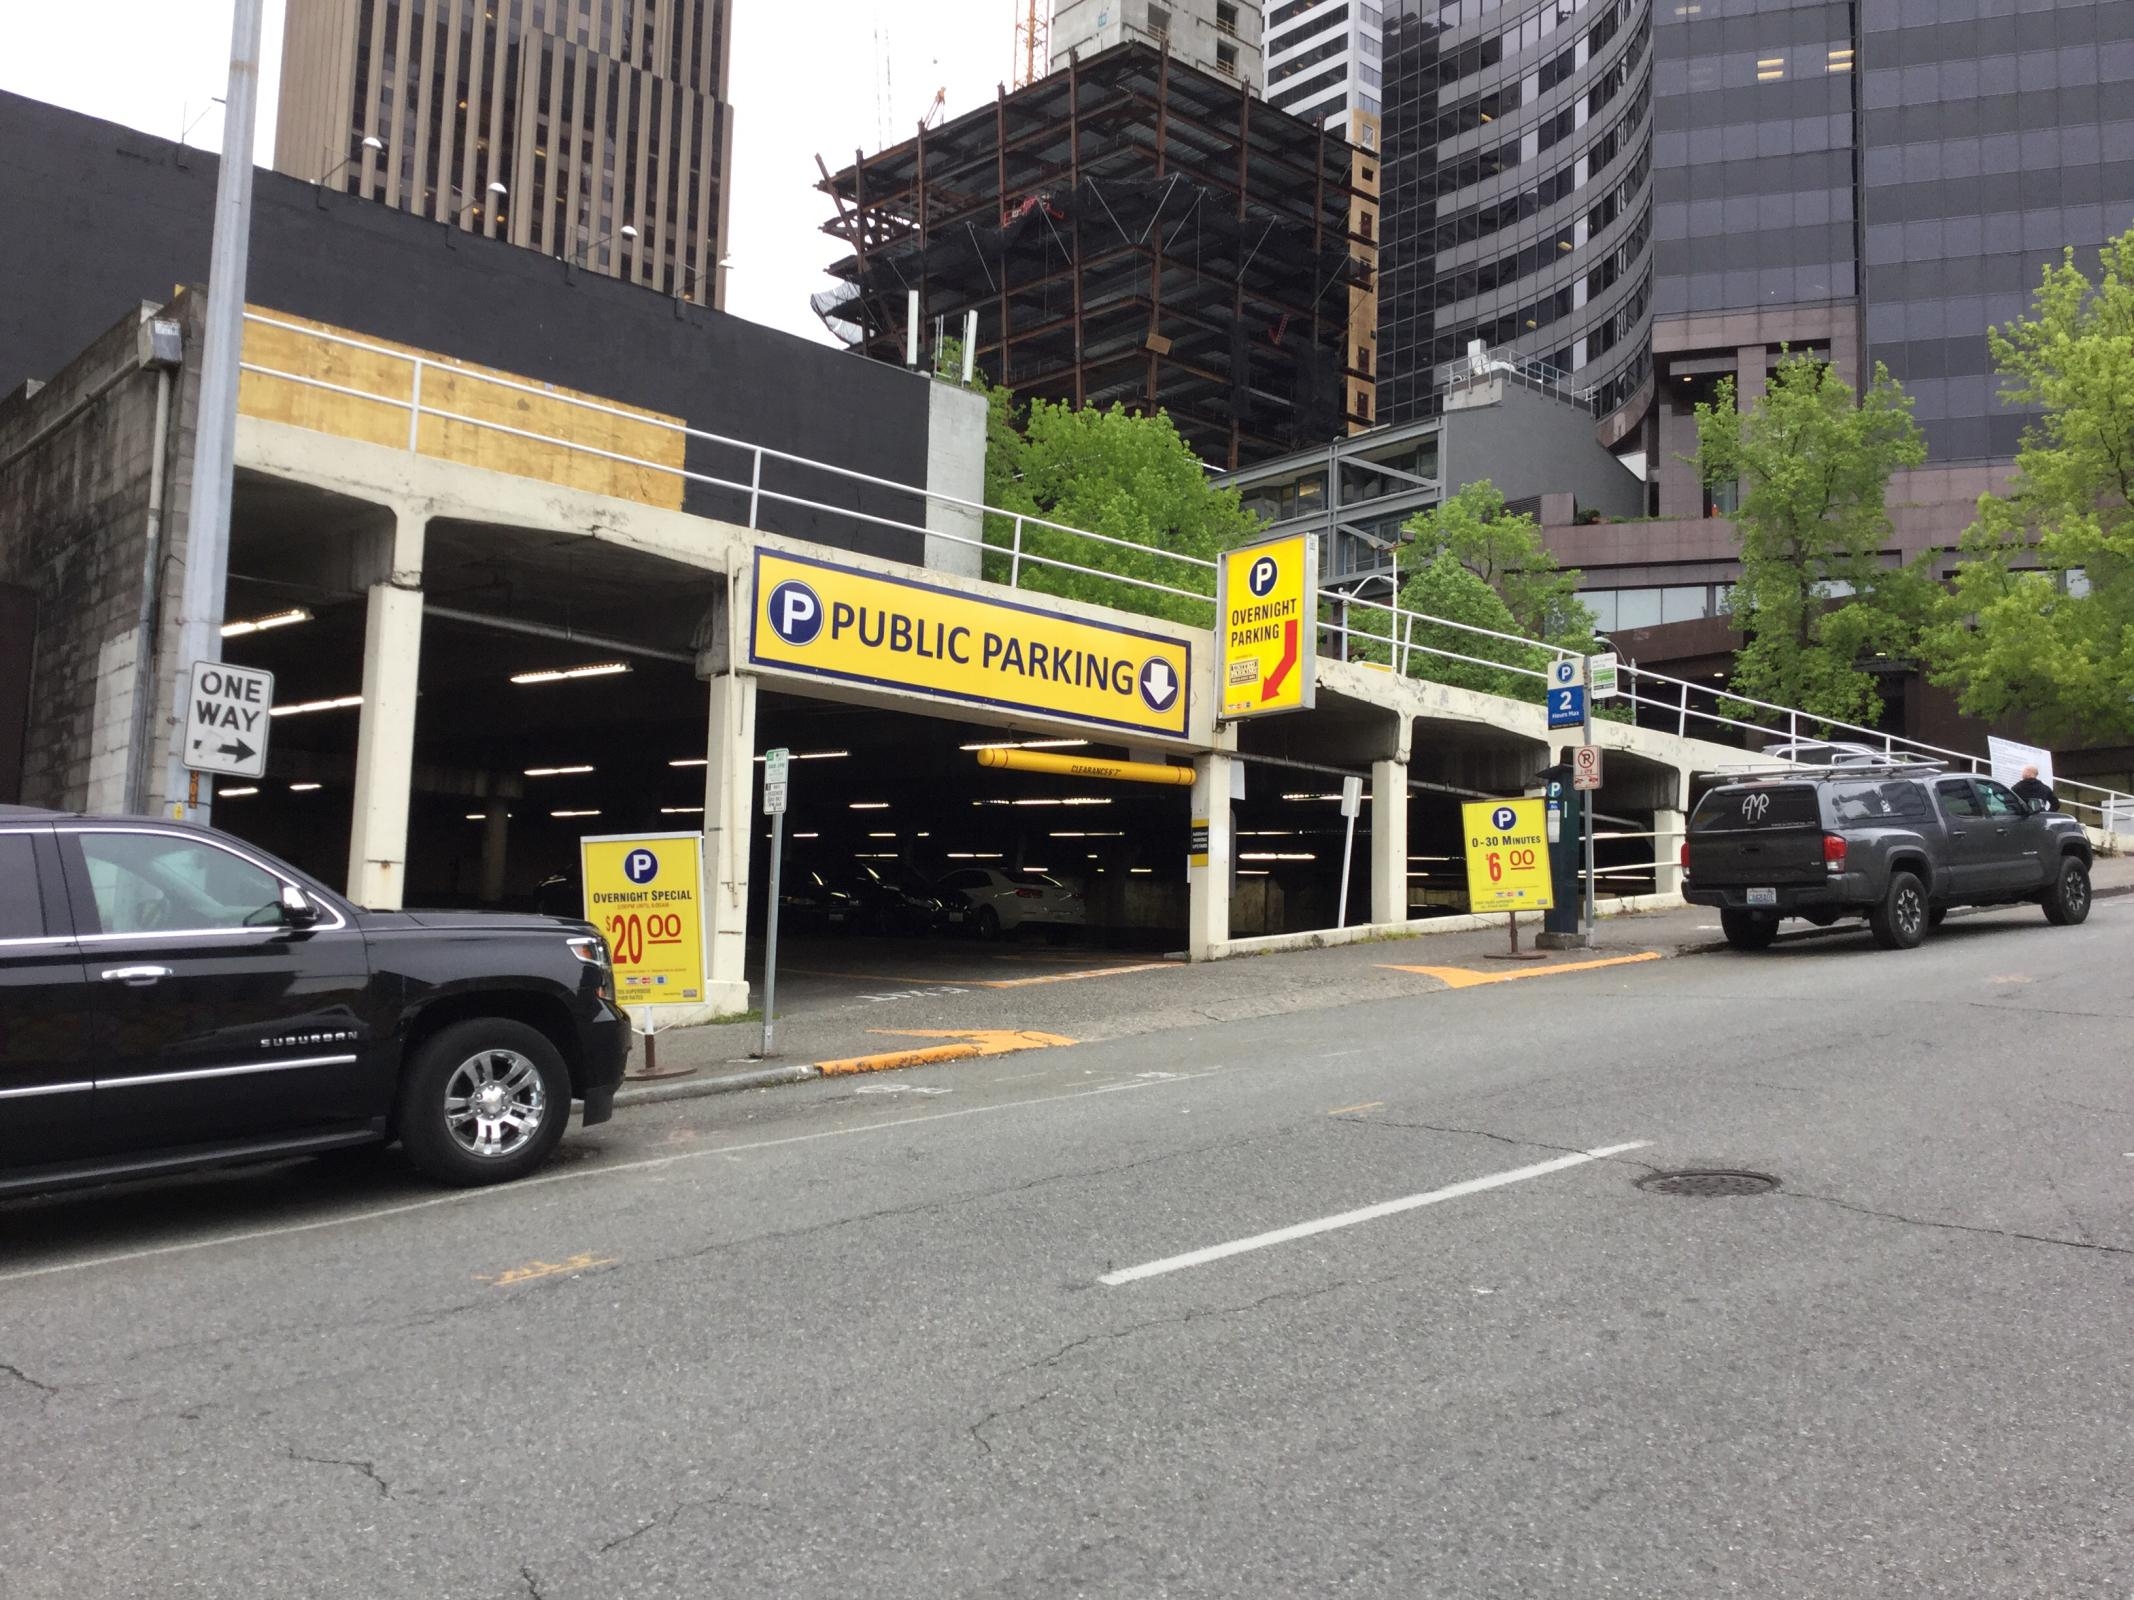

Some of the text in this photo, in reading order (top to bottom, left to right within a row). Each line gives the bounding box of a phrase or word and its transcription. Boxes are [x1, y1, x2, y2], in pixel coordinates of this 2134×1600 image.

[1256, 562, 1273, 592] P
[1231, 598, 1297, 627] OVERNIGHT
[782, 590, 1134, 695] P PUBLIC PARKING
[1231, 623, 1280, 647] PARKING
[200, 671, 263, 704] ONE
[1559, 691, 1572, 710] 2
[196, 699, 261, 733] WAY
[1498, 810, 1512, 828] P
[1502, 835, 1541, 846] MINUTES
[632, 854, 652, 879] P
[593, 889, 692, 903] OVERNIGHT SPECIAL
[260, 1031, 358, 1048] SUBURBAN
